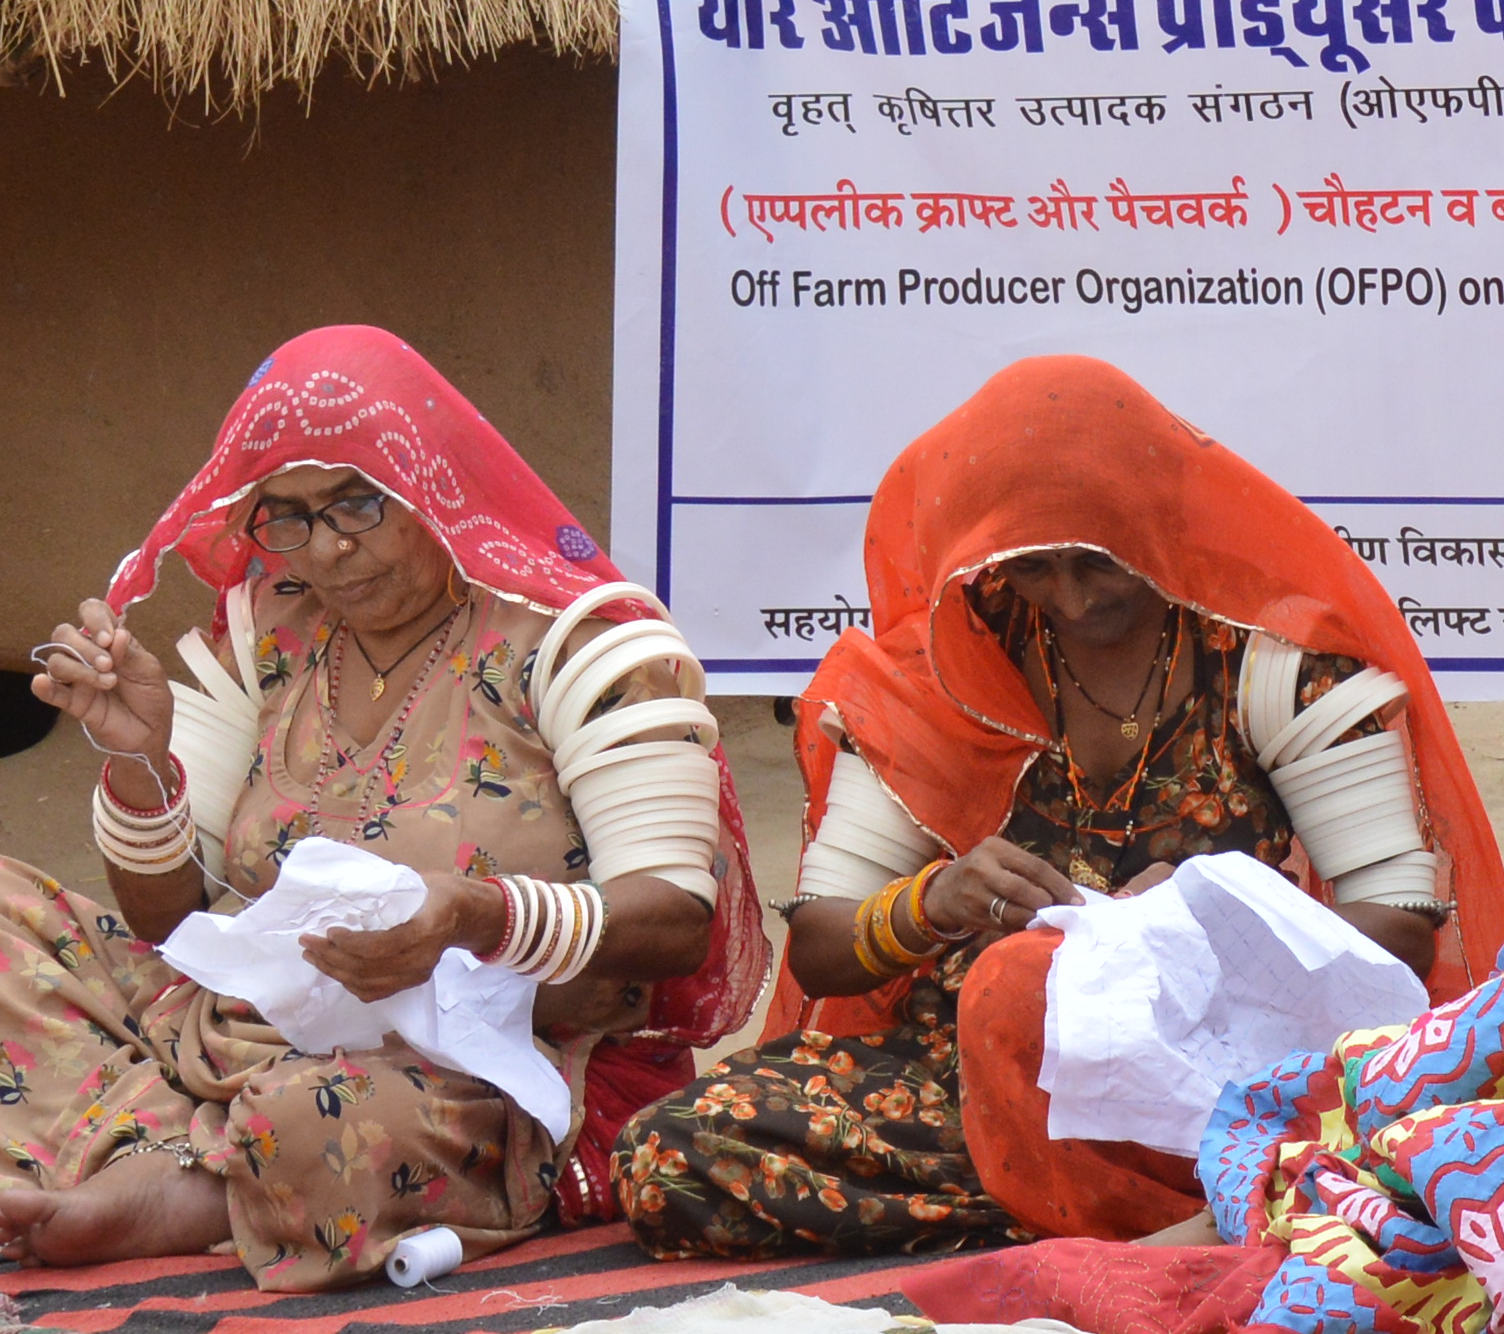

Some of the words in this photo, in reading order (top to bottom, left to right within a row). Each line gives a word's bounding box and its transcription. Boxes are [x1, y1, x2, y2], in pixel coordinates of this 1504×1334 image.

[768, 94, 856, 136] वृहत्
[1015, 95, 1166, 126] उत्पादक
[1188, 84, 1313, 122] संगठन
[911, 193, 1018, 233] क्राफ्ट
[1028, 179, 1099, 230] और
[1297, 172, 1433, 233] चौहटन
[1441, 189, 1480, 227] व
[732, 270, 780, 307] Off
[793, 271, 886, 307] Farm
[899, 268, 1065, 305] Producer
[1076, 268, 1302, 313] Organization
[1316, 267, 1446, 315] (OFPO)
[1459, 277, 1504, 305] on
